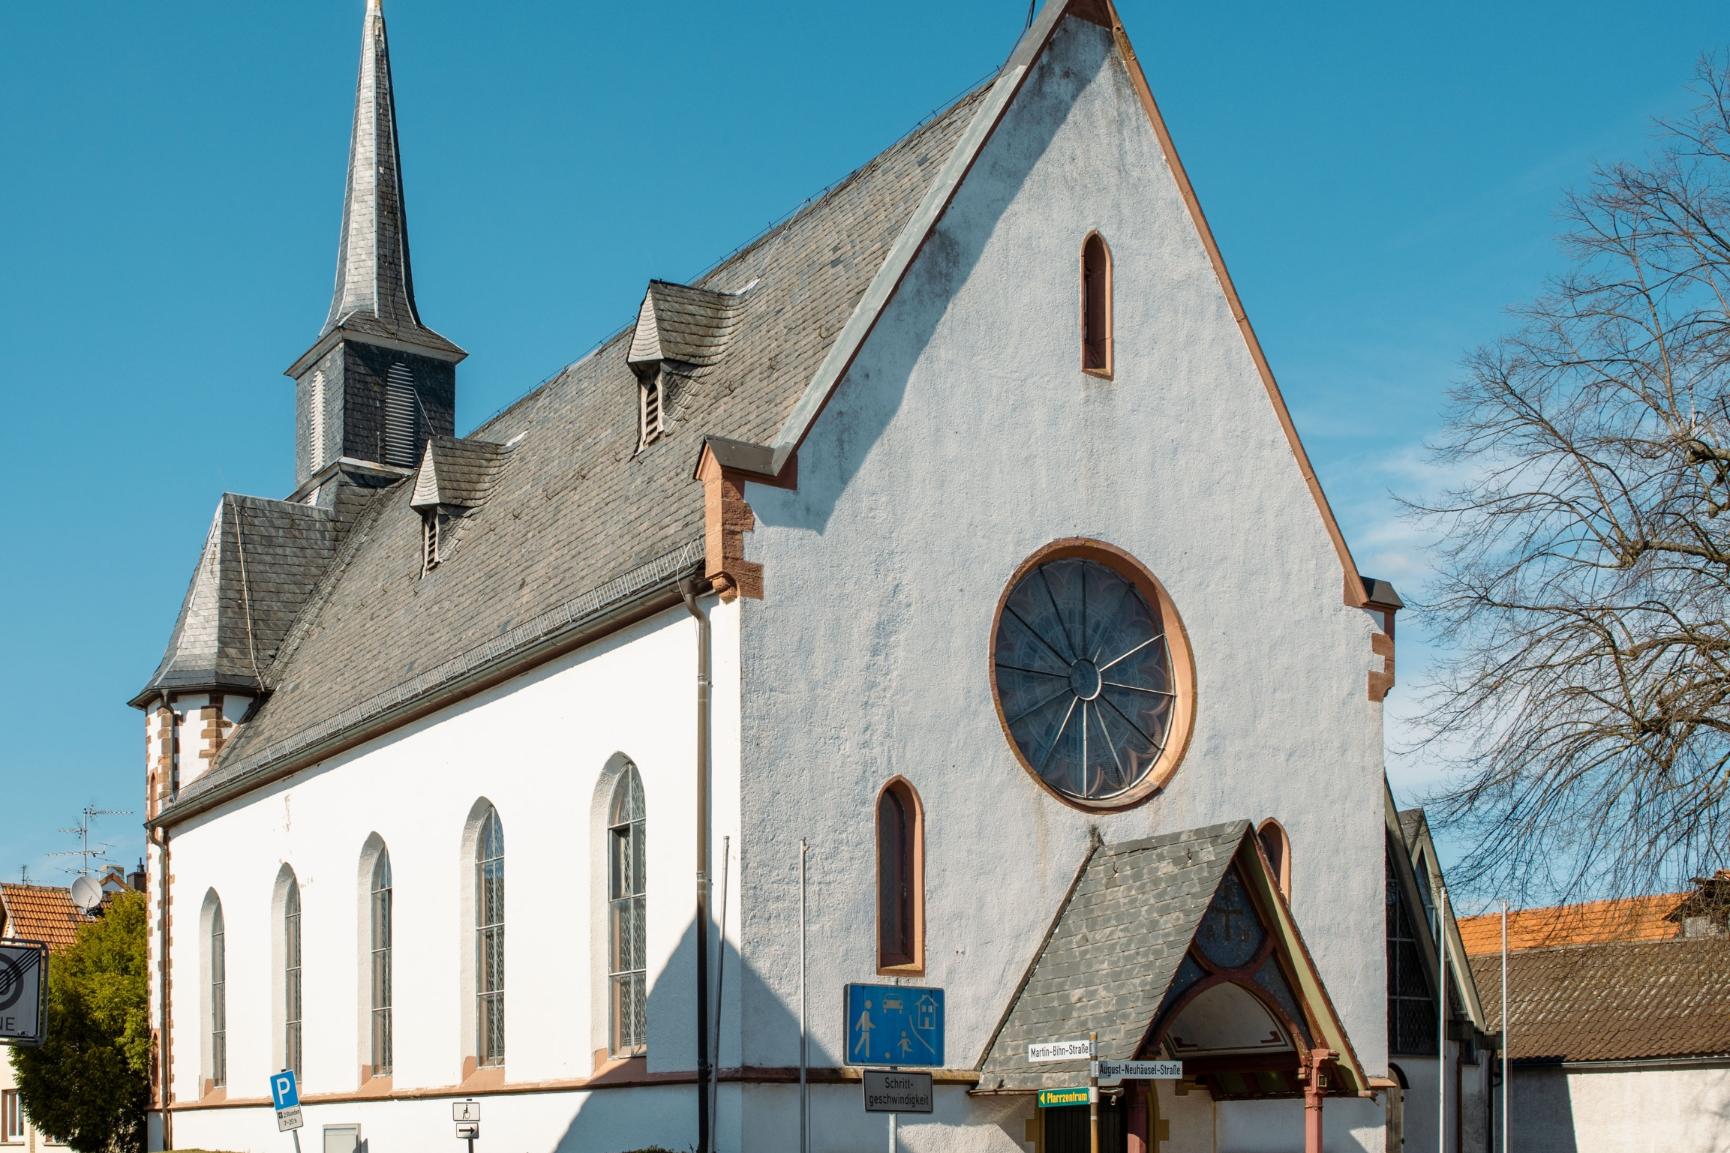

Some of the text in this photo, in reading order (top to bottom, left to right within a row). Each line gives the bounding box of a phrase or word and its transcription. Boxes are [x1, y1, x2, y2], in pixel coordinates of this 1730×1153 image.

[1100, 1063, 1180, 1077] August-Neuhäusel-Straße
[276, 1077, 291, 1105] P
[1046, 1091, 1088, 1104] Pfarrzentrum
[869, 1093, 929, 1108] geschwindigkeit
